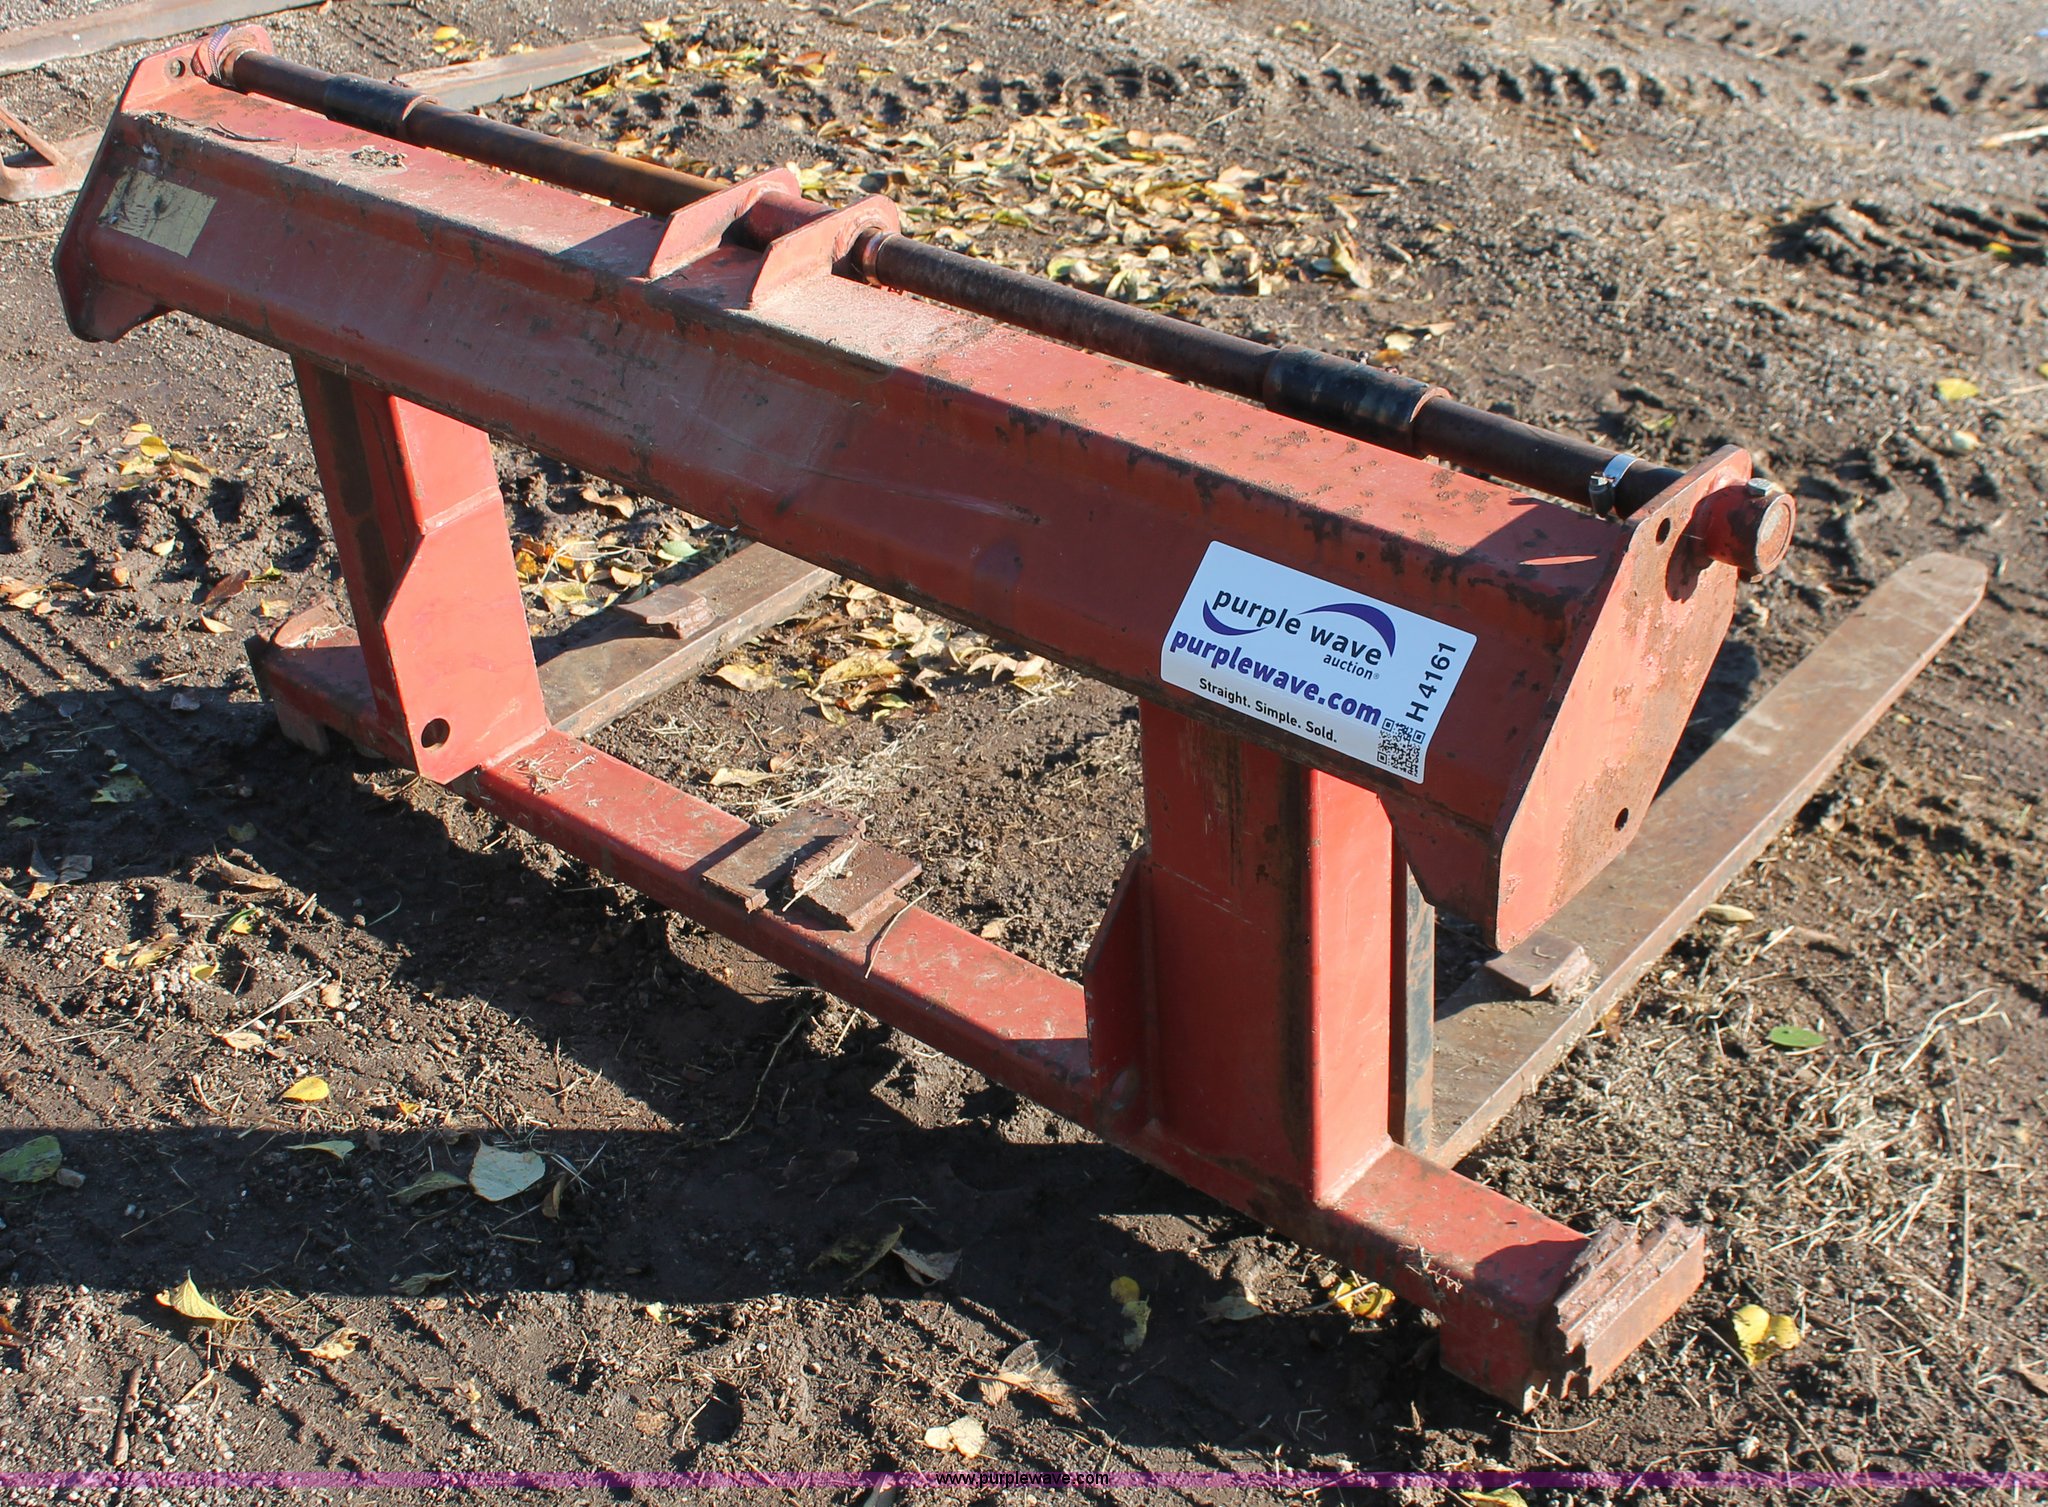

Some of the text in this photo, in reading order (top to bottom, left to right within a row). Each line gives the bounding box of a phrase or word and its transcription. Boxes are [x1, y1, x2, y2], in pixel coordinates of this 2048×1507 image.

[1212, 590, 1382, 666] purple wave
[1170, 630, 1382, 726] purplewave.com
[1199, 677, 1338, 743] Straight. Simple. Sold.
